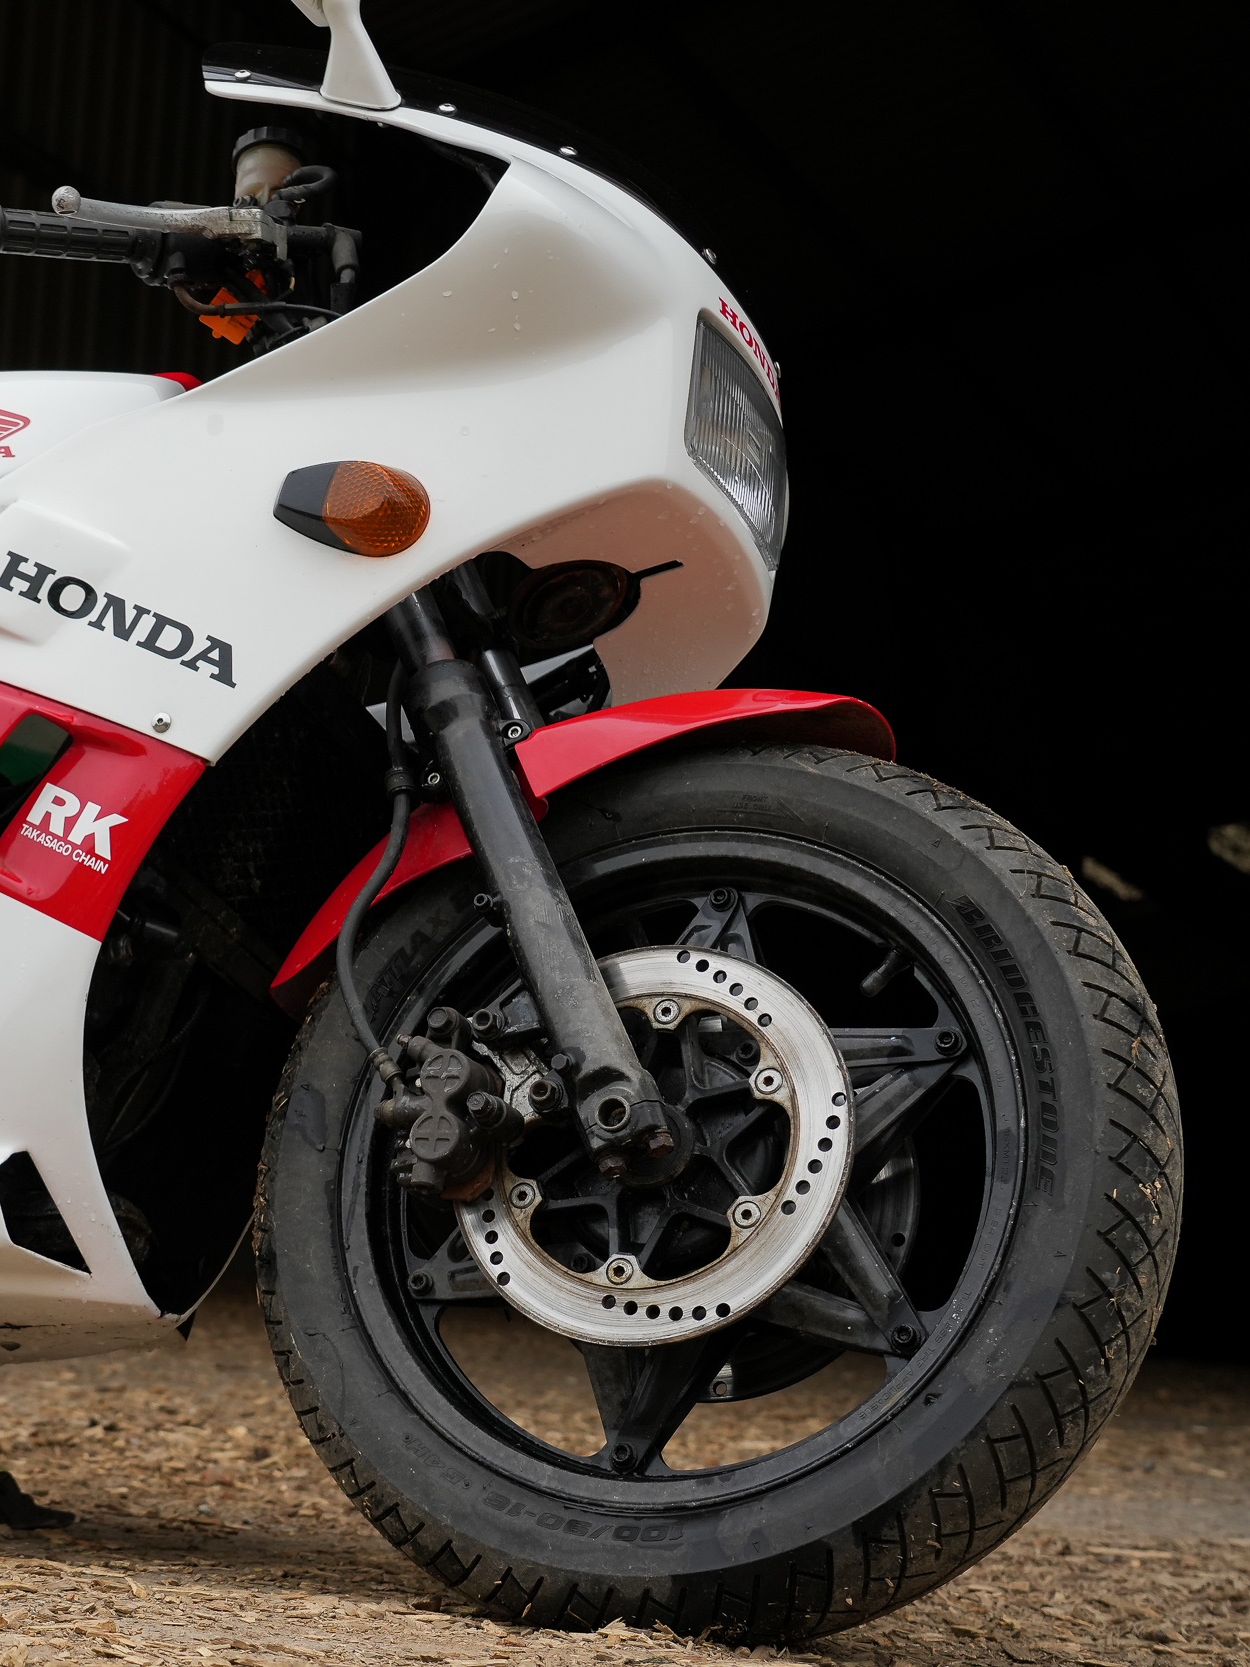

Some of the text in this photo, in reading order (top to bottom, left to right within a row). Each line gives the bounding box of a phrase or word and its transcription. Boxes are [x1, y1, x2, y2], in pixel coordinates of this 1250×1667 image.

[20, 823, 109, 875] TAKASAGO CHAIN
[25, 782, 129, 861] RK
[946, 893, 1060, 1197] BRIDGESTONE
[482, 1491, 686, 1542] 100/90-16
